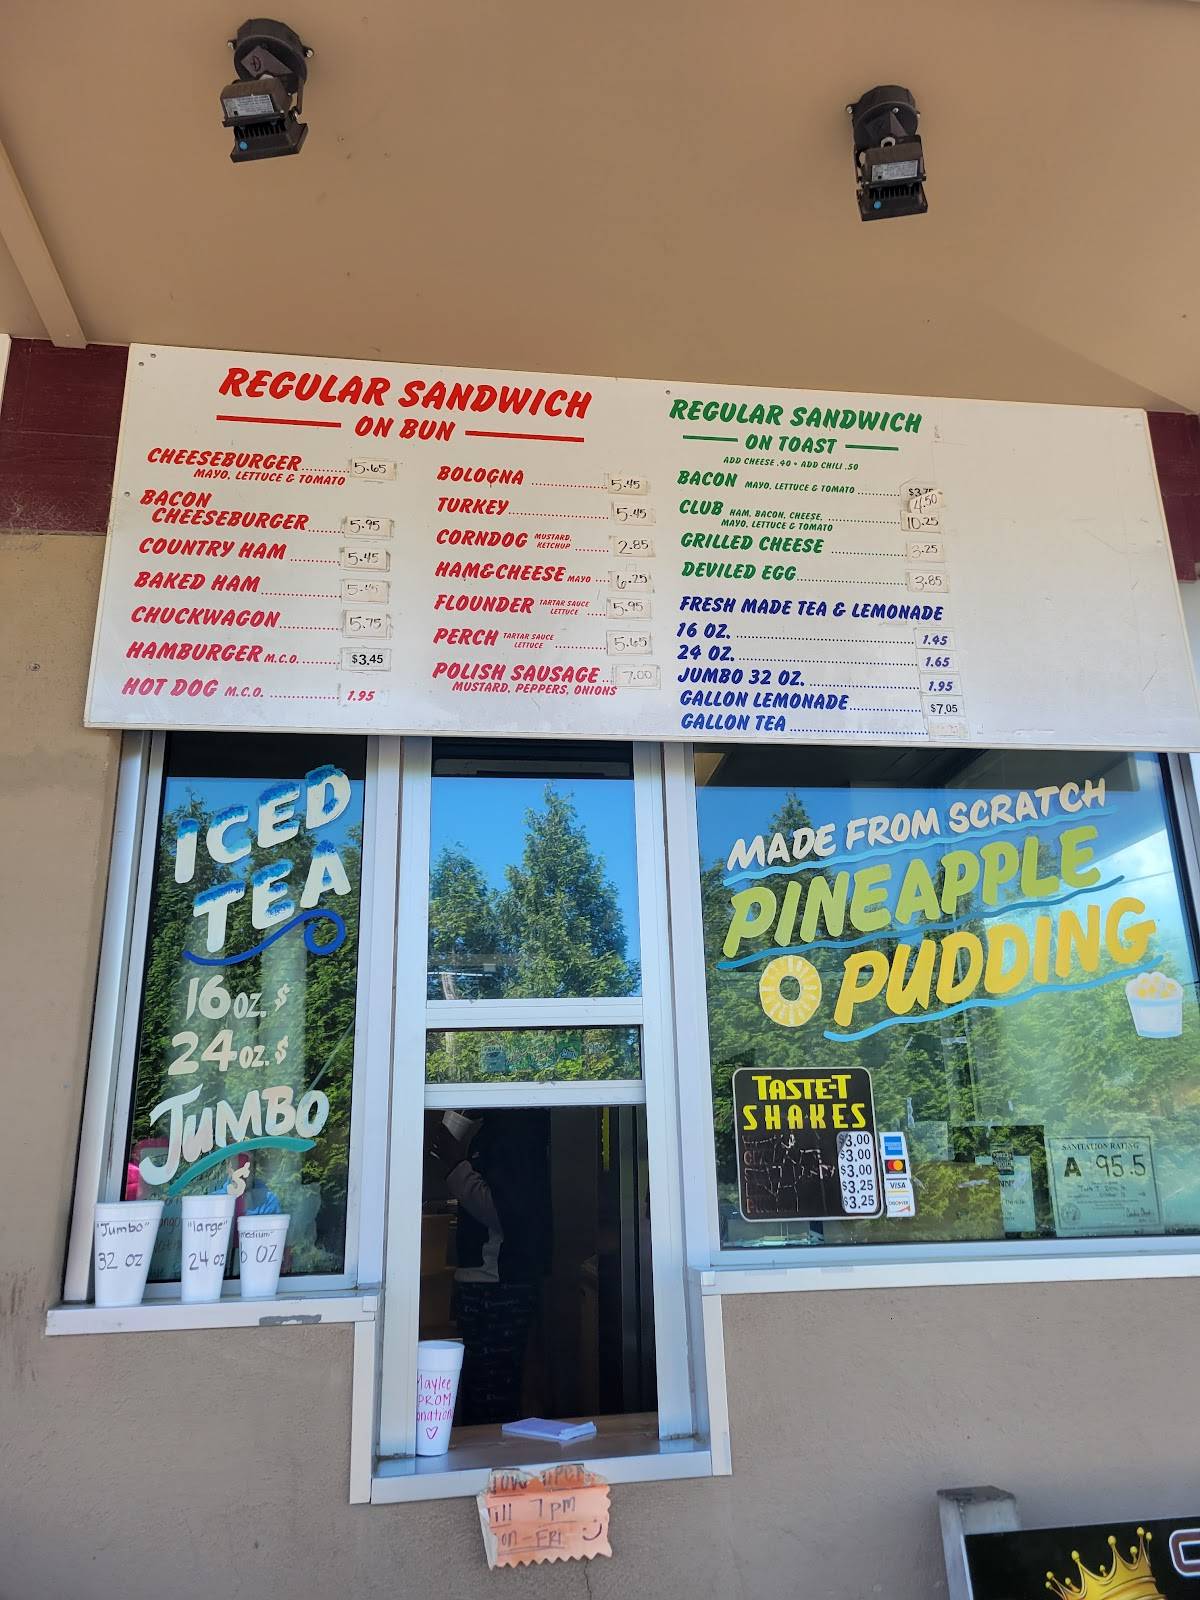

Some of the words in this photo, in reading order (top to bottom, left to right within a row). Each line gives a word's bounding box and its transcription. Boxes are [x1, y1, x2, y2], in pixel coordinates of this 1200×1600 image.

[218, 368, 391, 406] REGULAR
[398, 380, 592, 419] SANDWICH
[669, 399, 784, 426] REGULAR
[790, 406, 923, 433] SANDWICH
[354, 416, 394, 438] ON
[399, 418, 456, 442] BUN
[745, 435, 775, 450] ON
[779, 436, 837, 454] TOAST
[147, 447, 302, 471] CHEESEBURGER
[354, 462, 387, 475] 5.65
[723, 456, 741, 464] ADD
[744, 458, 775, 466] CHEESE
[776, 459, 791, 467] .40
[800, 460, 818, 468] ADD
[820, 461, 843, 470] CHILI
[844, 463, 859, 471] .50
[235, 470, 283, 482] LETTUCE
[286, 474, 295, 482] &
[299, 474, 346, 486] TOMATO
[437, 466, 524, 485] BOLOGNA
[676, 470, 738, 487] BACON
[774, 482, 809, 491] LETTUCE
[812, 484, 818, 492] &
[821, 485, 855, 494] TOMATO
[611, 479, 640, 492] 5.45
[140, 490, 212, 508] BACON
[437, 497, 509, 515] TURKEY
[679, 499, 724, 516] CLUB
[914, 494, 937, 514] 4.50
[152, 508, 309, 531] CHEESEBURGER
[616, 507, 646, 522] 5.45
[908, 517, 939, 530] 10.25
[350, 519, 380, 533] 5.95
[751, 521, 786, 529] LETTUCE
[799, 523, 833, 532] TOMATO
[436, 528, 528, 548] CORNDOG
[537, 542, 571, 550] KETCHUP
[618, 540, 648, 554] 2.85
[681, 532, 753, 551] GRILLED
[759, 536, 825, 554] CHEESE
[138, 537, 234, 558] COUNTRY
[239, 541, 287, 560] HAM
[681, 561, 756, 580] DEVILED
[762, 565, 797, 581] EGG
[134, 572, 206, 591] BAKED
[211, 575, 261, 593] HAM
[616, 574, 647, 589] 6.25
[914, 575, 942, 588] 3.85
[433, 594, 535, 614] FLOUNDER
[567, 600, 590, 608] SAUCE
[613, 601, 643, 616] 5.95
[680, 596, 736, 612] FRESH
[741, 598, 792, 615] MADE
[798, 600, 827, 616] TEA
[833, 602, 846, 617] &
[852, 603, 943, 621] LEMONADE
[131, 606, 280, 629] CHUCKWAGON
[350, 616, 382, 631] 5.75
[433, 628, 499, 646] PERCH
[677, 623, 697, 638] 16
[704, 624, 731, 639] OZ.
[922, 635, 948, 645] 1.45
[126, 641, 263, 662] HAMBURGER
[264, 654, 299, 664] M.C.O.
[352, 654, 383, 666] $3.45
[677, 645, 701, 661] 24
[708, 646, 735, 662] OZ.
[925, 657, 950, 667] 1.65
[432, 662, 506, 681] POLISH
[510, 665, 600, 684] SAUSAGE
[622, 670, 652, 684] 7.00
[677, 667, 743, 684] JUMBO
[749, 670, 772, 685] 32
[778, 671, 805, 687] OZ.
[122, 677, 168, 696] HOT
[170, 678, 219, 697] DOG
[224, 686, 264, 698] M.C.O.
[347, 690, 375, 701] 1.95
[574, 685, 618, 696] ONIONS
[928, 681, 953, 691] 1.95
[680, 690, 748, 707] GALLON
[753, 692, 850, 710] LEMONADE
[930, 704, 958, 715] $7.05
[681, 713, 750, 731] GALLON
[755, 715, 786, 732] TEA
[174, 764, 351, 884] ICED
[727, 823, 836, 871] MADE
[845, 807, 939, 851] FROM
[948, 778, 1106, 834] SCRATCH
[193, 839, 352, 953] TEA
[722, 825, 1101, 958] PINEAPPLE
[834, 897, 1156, 1028] PUDDING
[274, 983, 290, 1012] $
[275, 1035, 289, 1064] $
[742, 1103, 866, 1131] SHAKES
[139, 1083, 330, 1185] JUMBO
[840, 1134, 869, 1147] $3.00
[840, 1149, 871, 1162] $3.00
[841, 1164, 872, 1178] $3.00
[1064, 1157, 1081, 1177] A
[1096, 1154, 1146, 1177] 95.5
[227, 1162, 250, 1198] $
[842, 1180, 874, 1194] $3.25
[844, 1195, 875, 1209] $3.25
[98, 1252, 118, 1271] 32
[189, 1251, 209, 1271] 24
[530, 1499, 543, 1517] 7
